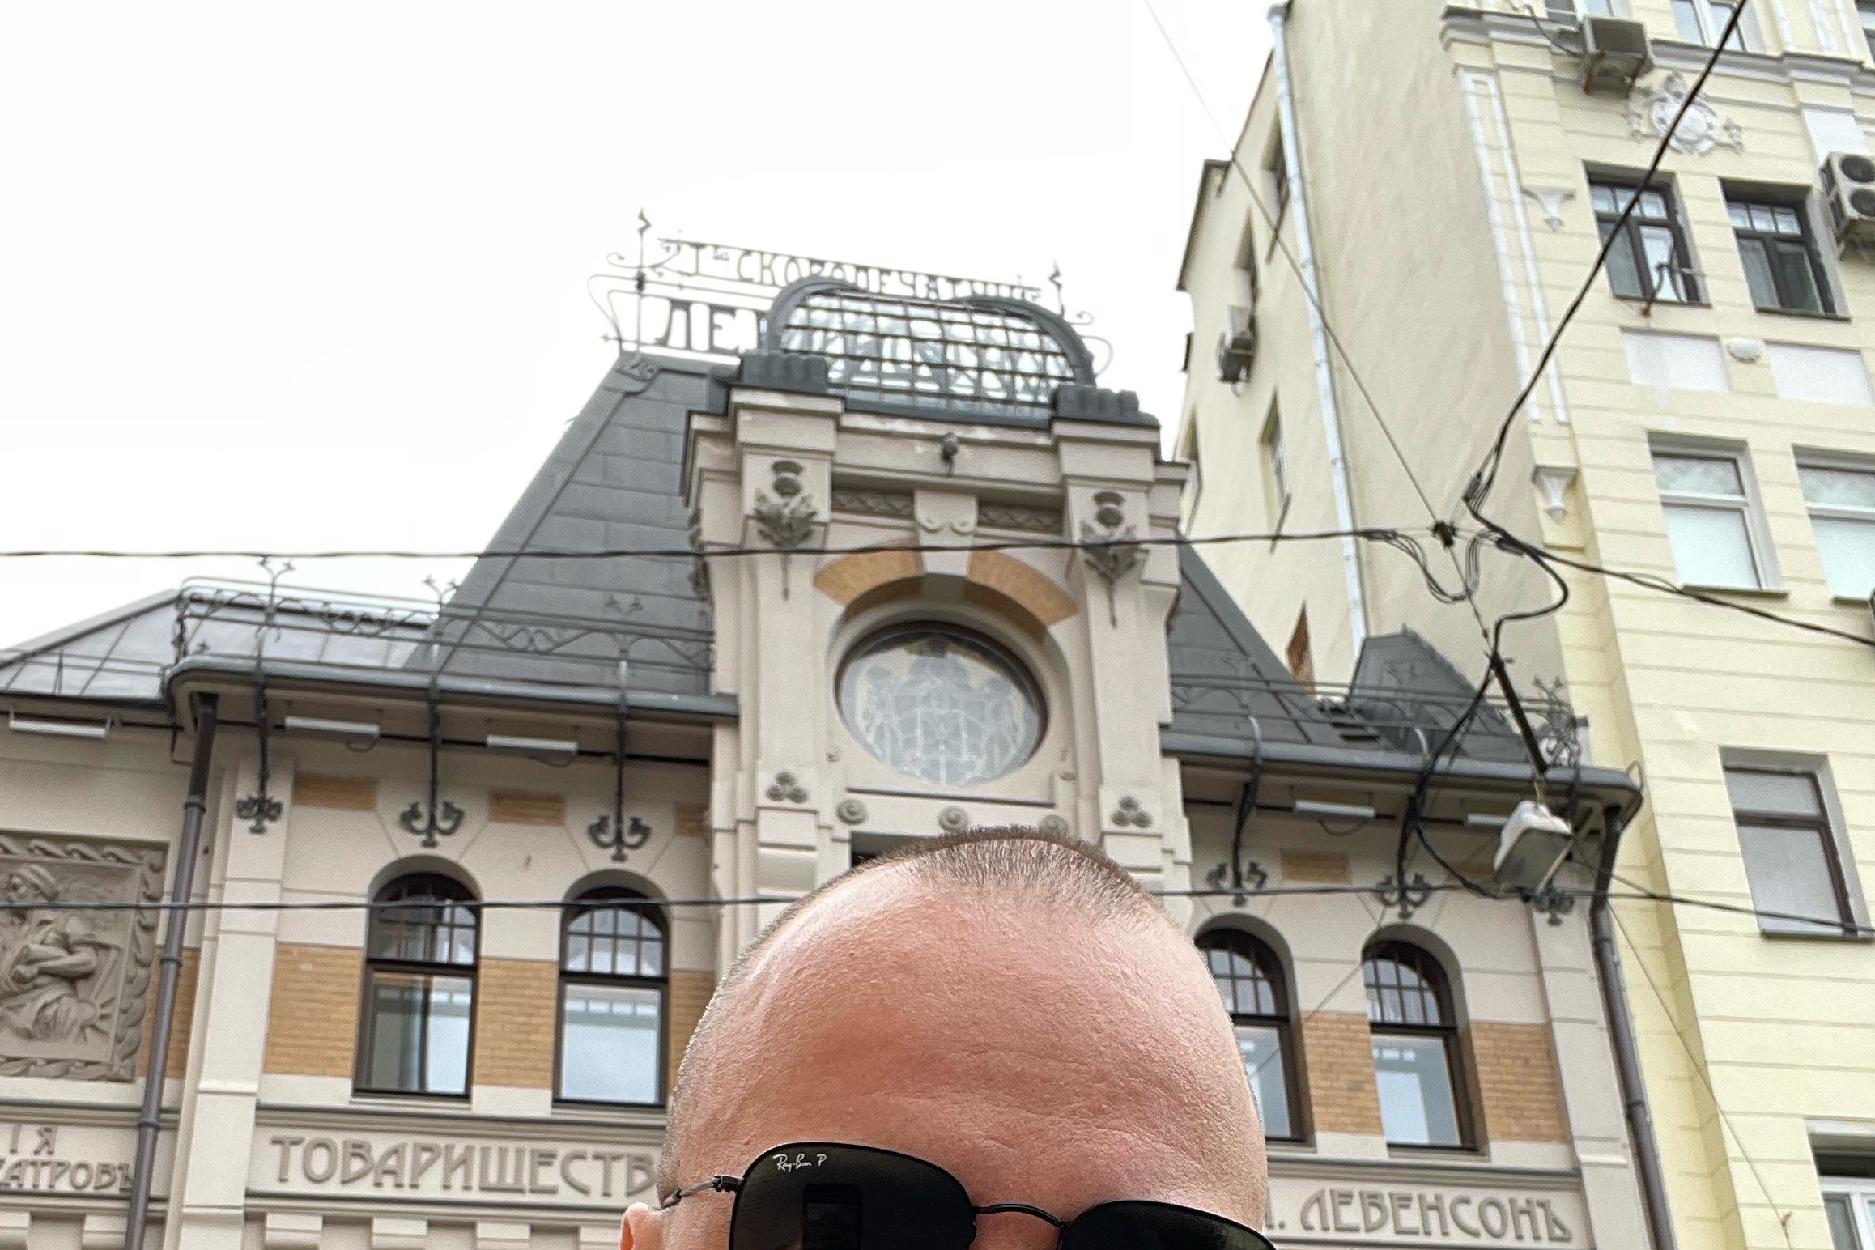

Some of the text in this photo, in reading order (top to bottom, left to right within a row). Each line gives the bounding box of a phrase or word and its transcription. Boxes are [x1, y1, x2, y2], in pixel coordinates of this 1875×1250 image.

[772, 1152, 827, 1173] Ray-Ban P
[1300, 1188, 1573, 1242] ЛЕВЕНСОНЪ
